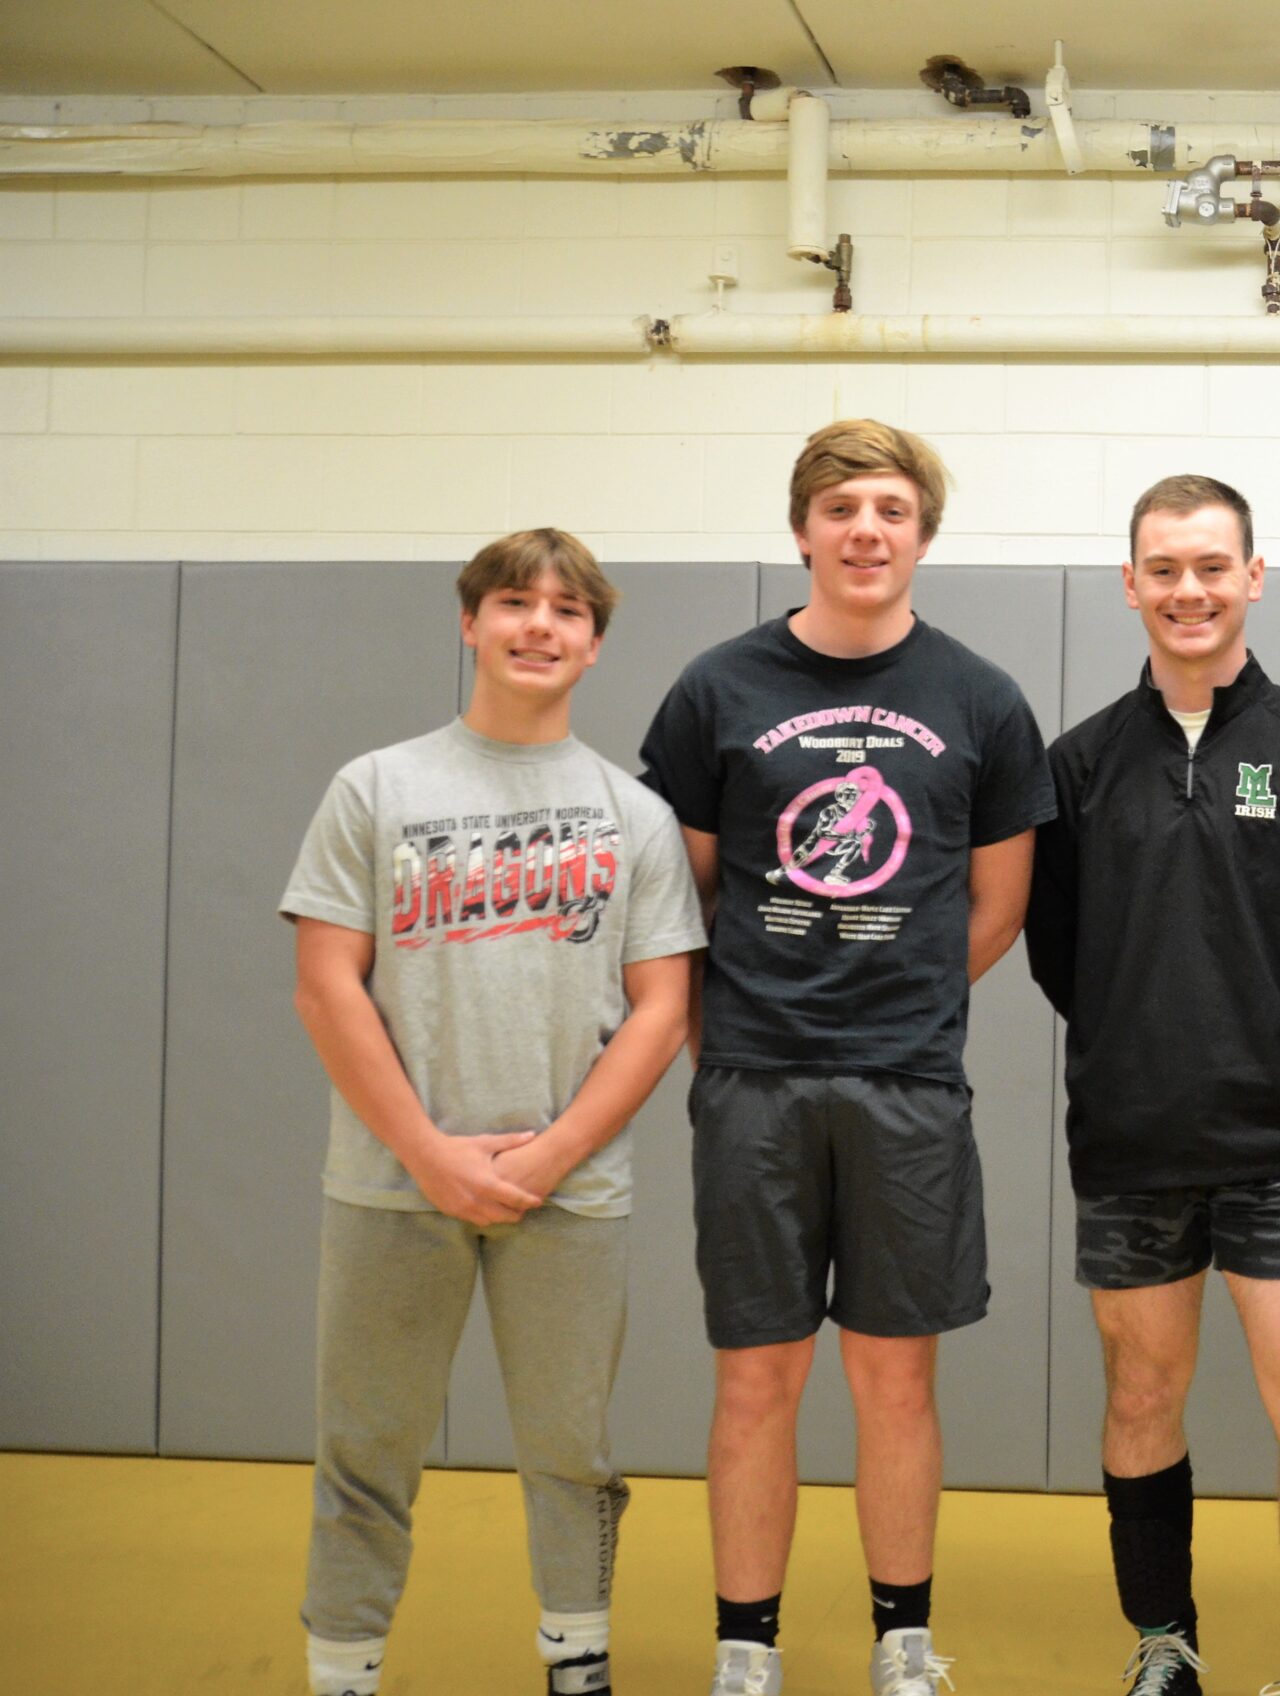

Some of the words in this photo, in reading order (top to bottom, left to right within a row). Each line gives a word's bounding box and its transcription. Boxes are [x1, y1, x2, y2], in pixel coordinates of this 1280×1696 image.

[752, 705, 873, 755] TAKEDOWN
[870, 707, 947, 758] CANCER
[835, 750, 866, 763] 2019
[402, 818, 457, 839] MINNESOTA
[461, 814, 491, 830] STATE
[494, 808, 551, 828] UNIVERSITY
[555, 806, 605, 820] MOORHEAD
[1234, 804, 1276, 819] IRISH
[391, 820, 620, 936] DRAGONS
